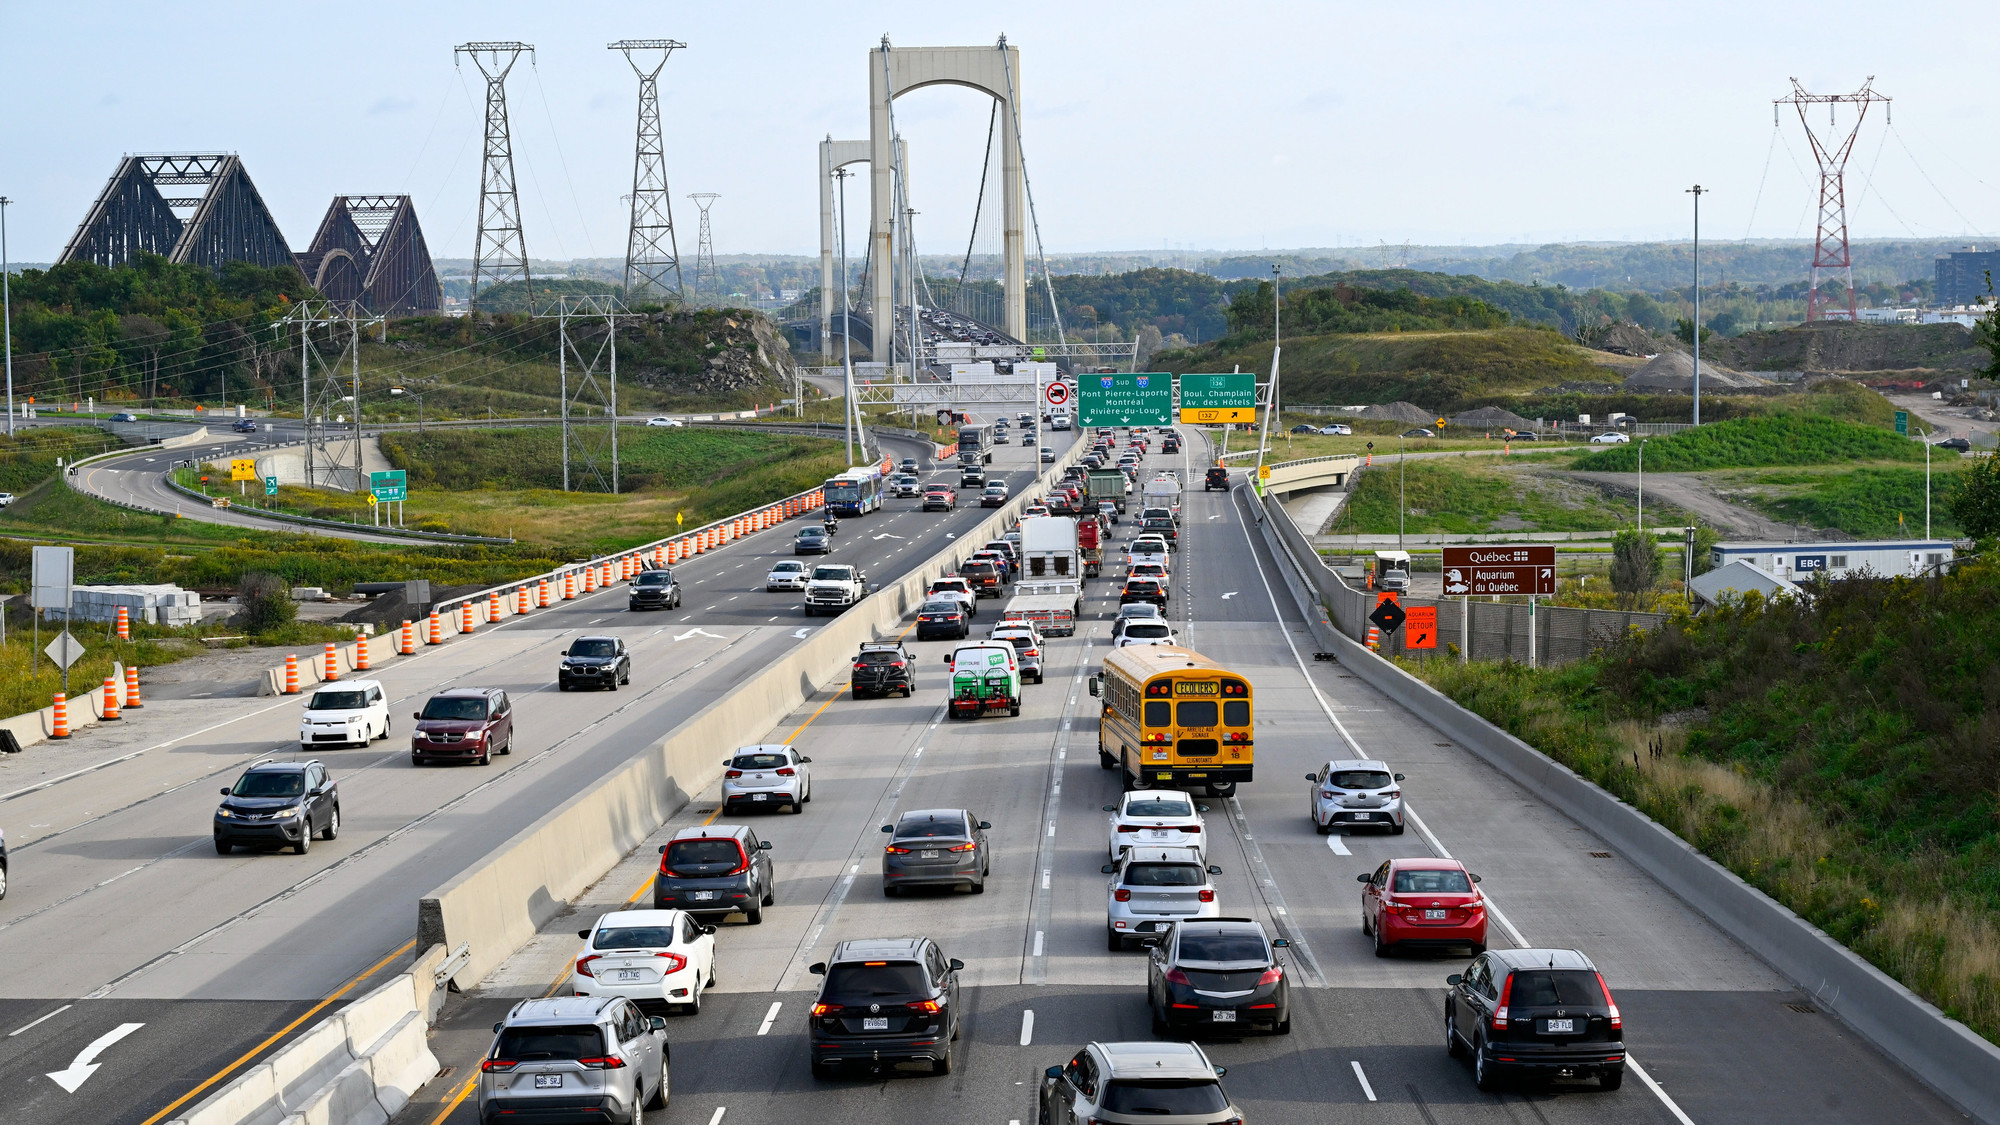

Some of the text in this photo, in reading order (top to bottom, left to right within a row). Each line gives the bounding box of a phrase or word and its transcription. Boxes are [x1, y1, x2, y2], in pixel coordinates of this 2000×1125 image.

[1081, 390, 1169, 398] Pont Pierre-Laporte
[1208, 390, 1252, 398] Champlain
[1105, 398, 1144, 406] Montréal
[1090, 407, 1160, 415] Rivière-du-Loup
[1469, 551, 1512, 564] Québec
[1800, 559, 1821, 568] EBC
[1475, 569, 1515, 582] Aquarium
[1475, 582, 1519, 592] du Québec
[1408, 621, 1434, 630] DÉTOUR
